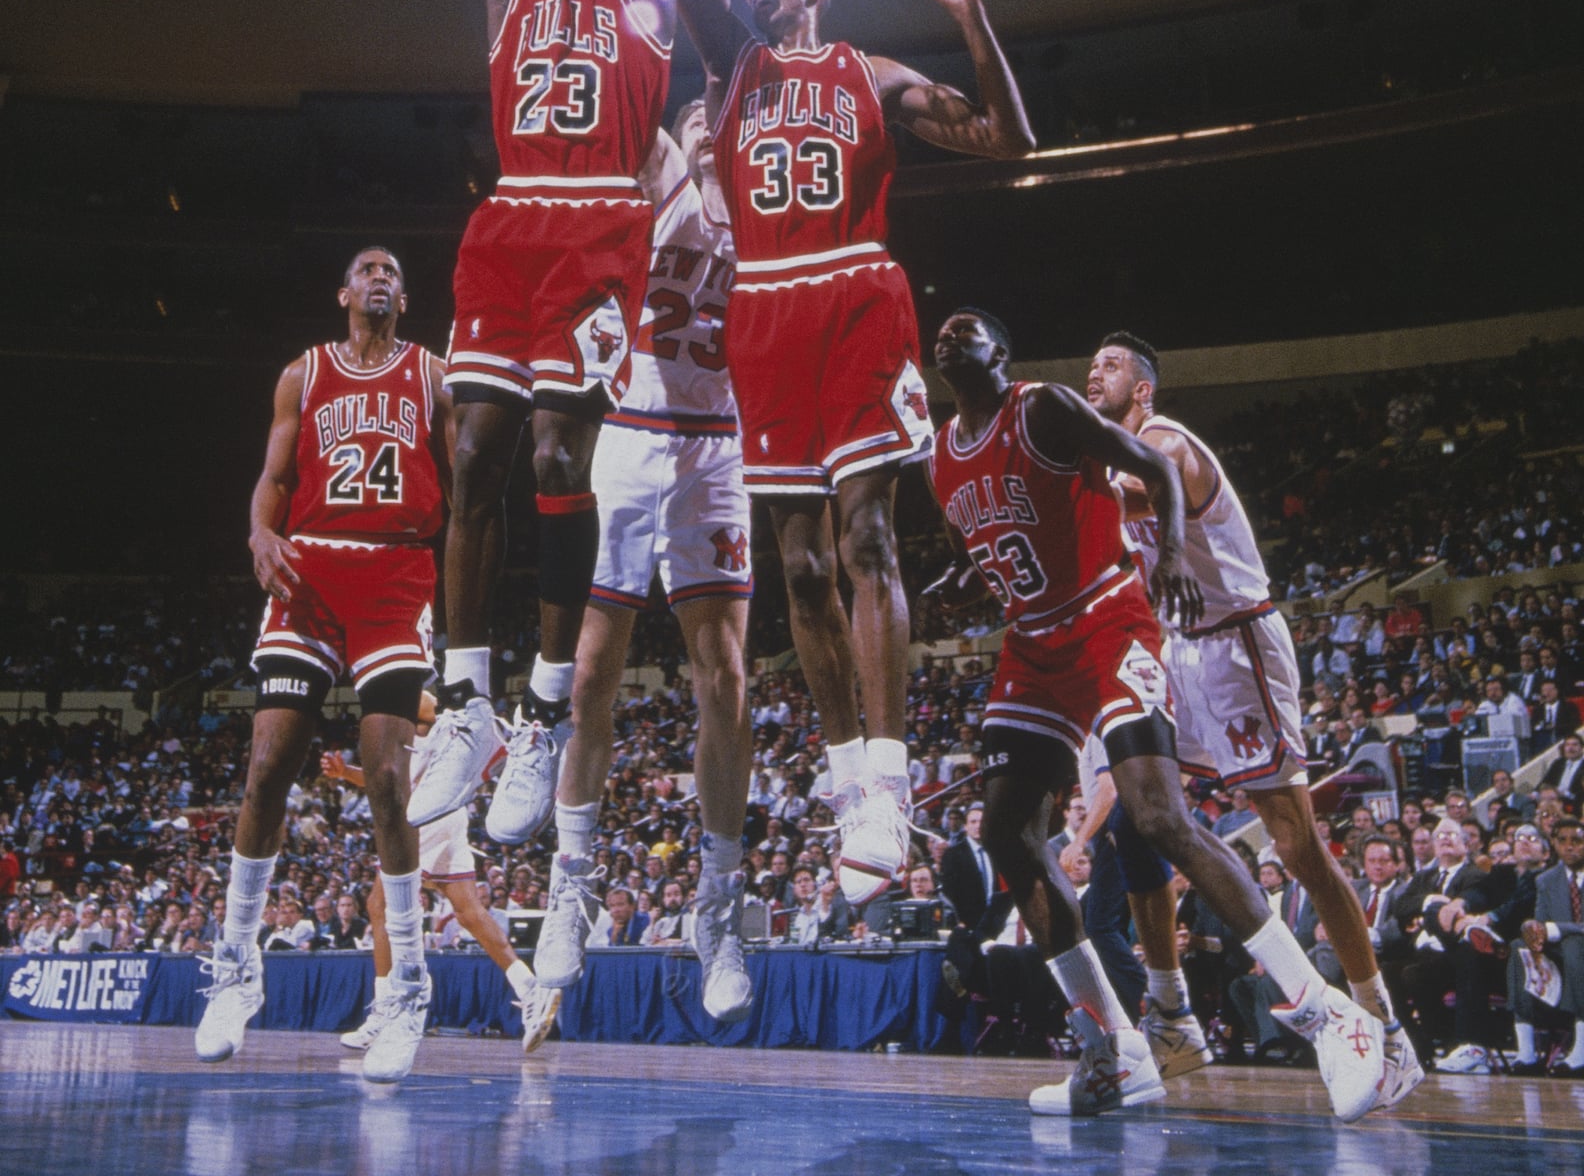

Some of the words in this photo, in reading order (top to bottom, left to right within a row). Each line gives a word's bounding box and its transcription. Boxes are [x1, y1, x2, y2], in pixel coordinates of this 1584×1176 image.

[512, 58, 600, 134] 23
[738, 79, 858, 152] BULLS
[749, 137, 843, 215] 33
[650, 244, 704, 282] EW
[315, 393, 417, 459] BULLS
[325, 442, 402, 505] 24
[968, 530, 1048, 607] 53
[269, 678, 309, 695] BULLS
